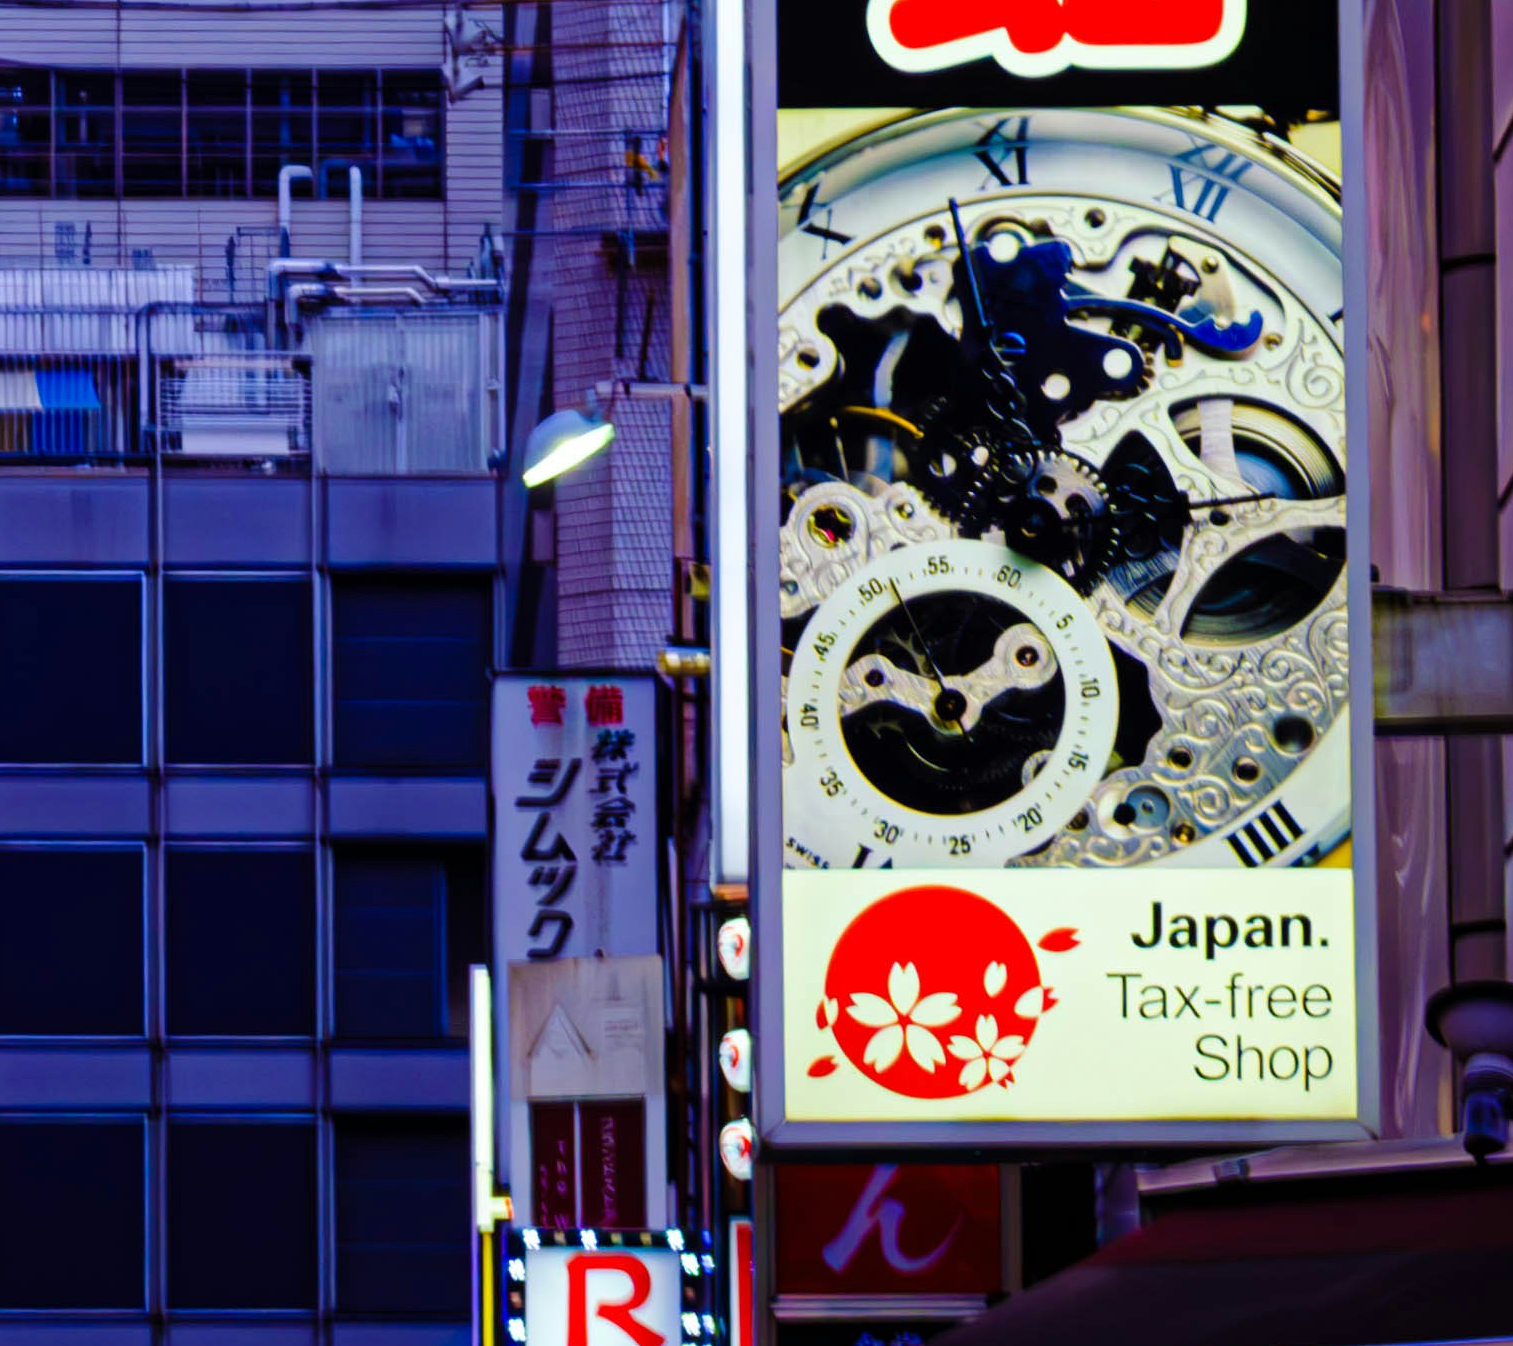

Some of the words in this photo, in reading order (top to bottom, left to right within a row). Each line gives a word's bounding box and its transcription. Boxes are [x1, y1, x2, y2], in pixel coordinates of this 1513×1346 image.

[927, 554, 952, 577] 55
[996, 565, 1022, 590] 60
[813, 631, 837, 660] 45
[1081, 673, 1100, 701] 10
[526, 686, 625, 726] 警備
[799, 701, 821, 729] 40
[1069, 748, 1089, 774] 15
[587, 730, 637, 866] 株式会社
[820, 770, 845, 801] 35
[874, 817, 902, 847] 30
[1015, 804, 1044, 834] 20
[515, 756, 584, 959] シムック
[947, 832, 974, 857] 25
[1130, 900, 1332, 957] Japan.
[1106, 971, 1333, 1021] Tax-free
[1193, 1032, 1333, 1091] Shop
